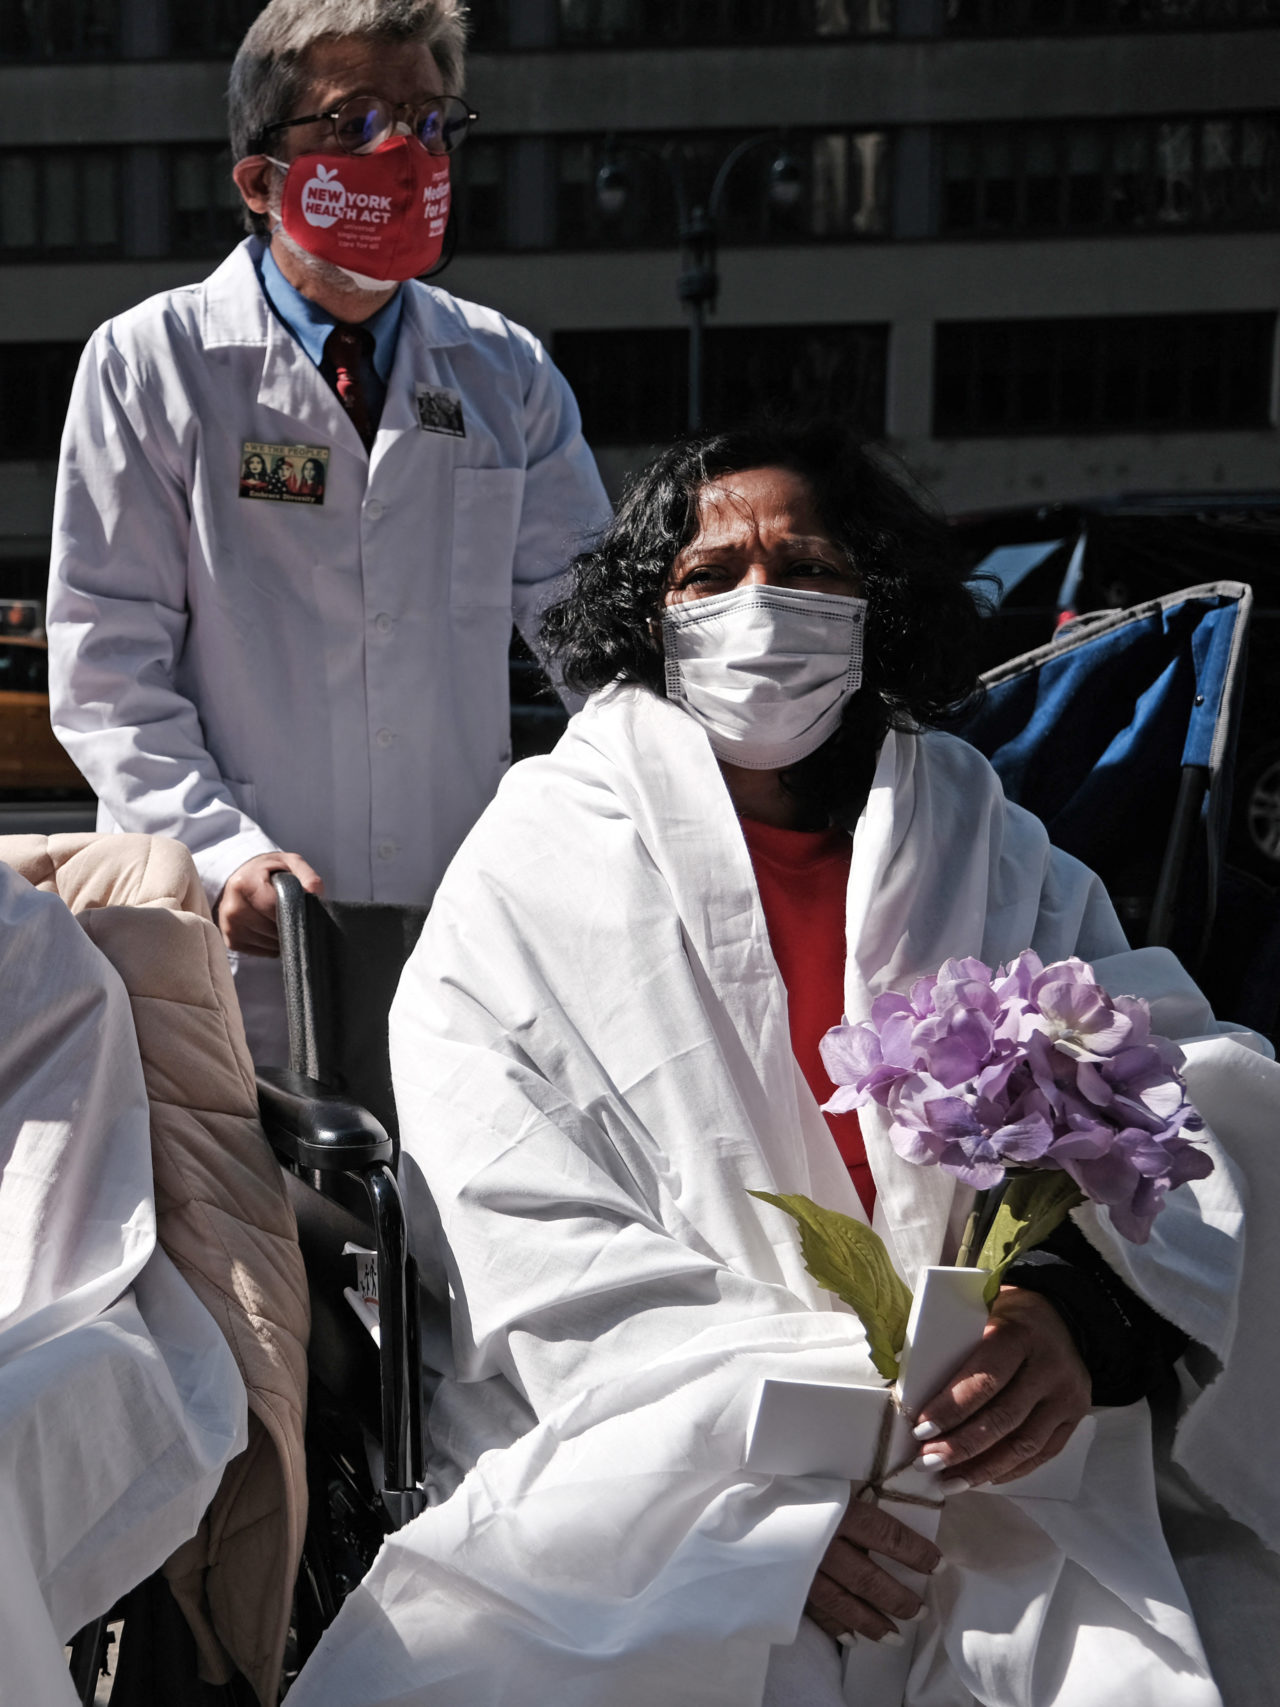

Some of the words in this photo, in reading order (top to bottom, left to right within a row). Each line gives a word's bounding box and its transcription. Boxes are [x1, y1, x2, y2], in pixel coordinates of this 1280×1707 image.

[307, 187, 342, 203] NEW
[346, 192, 392, 210] YORK
[305, 202, 358, 221] HEALTH
[360, 210, 391, 224] ACT
[288, 447, 322, 457] PEOPLE
